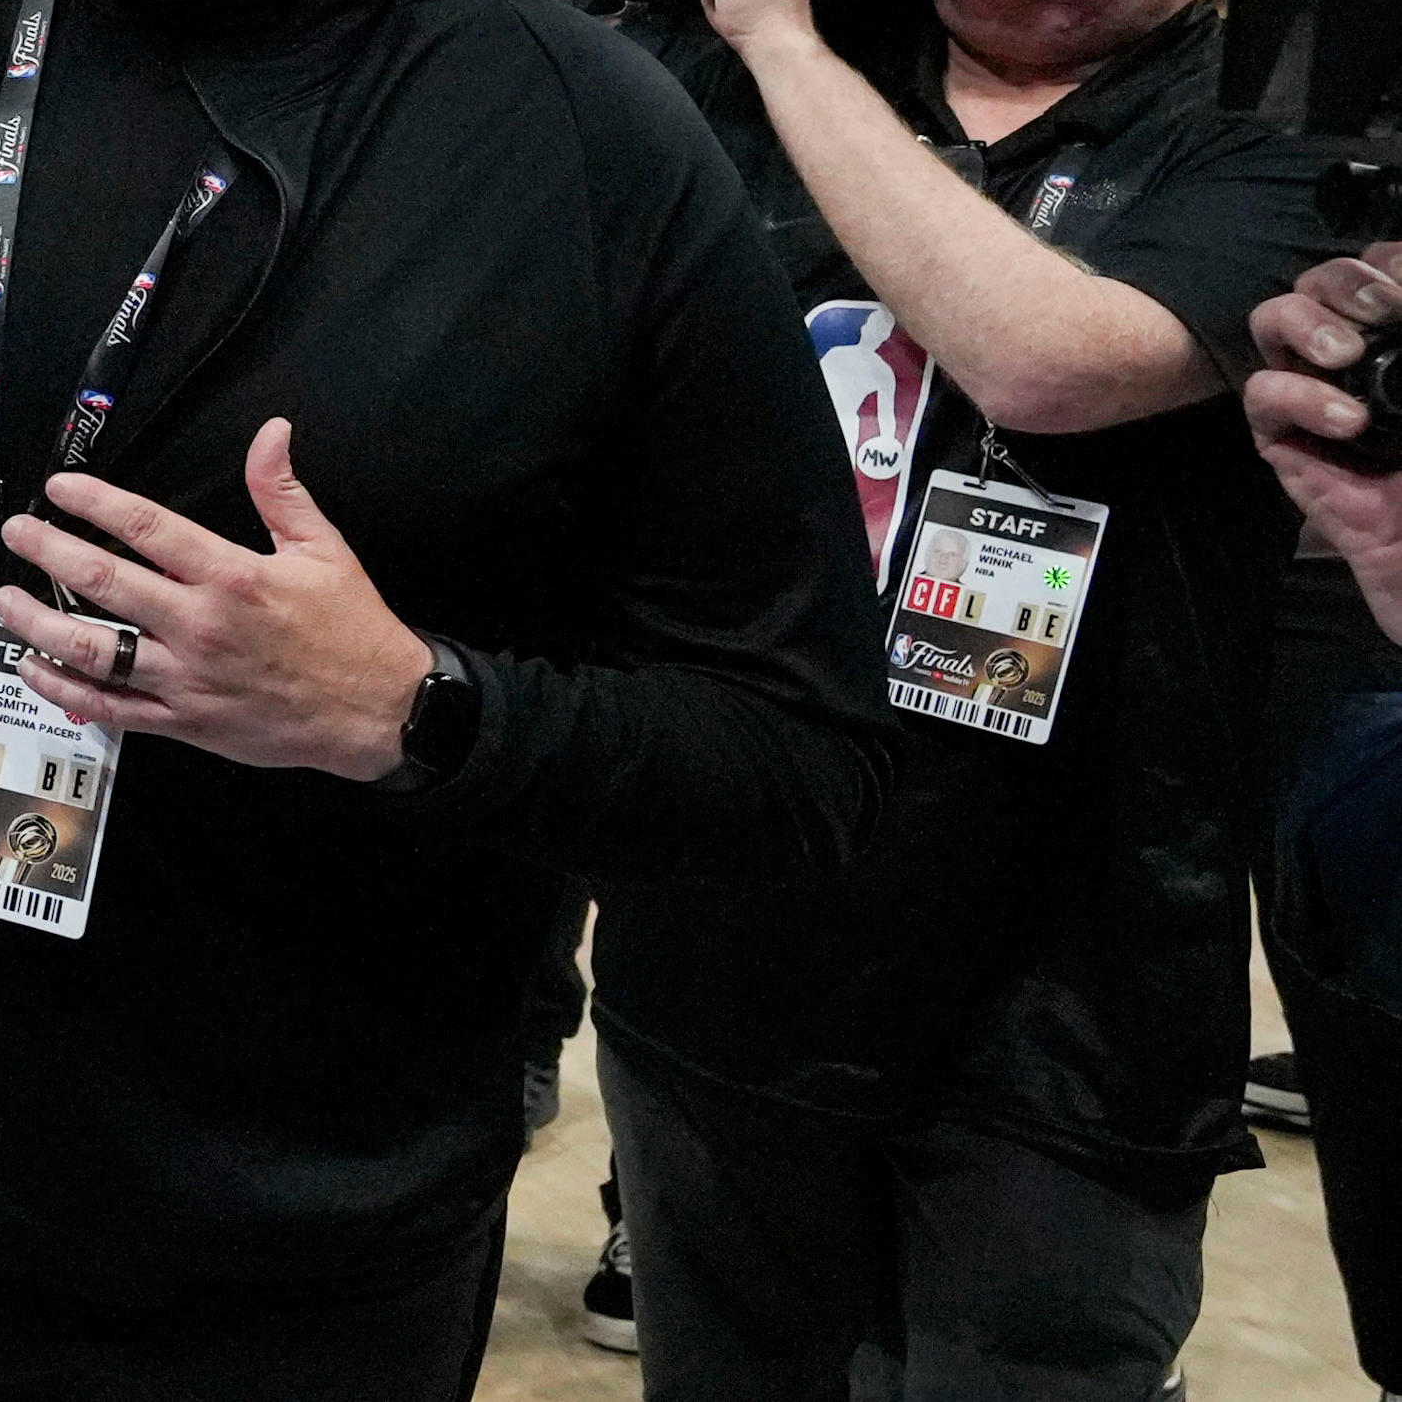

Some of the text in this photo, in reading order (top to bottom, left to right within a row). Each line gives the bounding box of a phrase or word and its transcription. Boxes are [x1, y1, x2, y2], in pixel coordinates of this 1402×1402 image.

[13, 11, 42, 68] Finals
[1031, 178, 1067, 229] Finals
[106, 287, 148, 348] Finals
[64, 398, 107, 467] Finals
[862, 447, 899, 468] MW
[969, 507, 1048, 539] STAFF
[979, 554, 1014, 570] WINIK
[981, 544, 1035, 564] MICHAEL
[912, 582, 974, 618] C F L
[1017, 607, 1059, 638] B E
[897, 640, 976, 678] Finals
[1022, 688, 1046, 707] 2025
[38, 723, 83, 741] PACERS
[41, 760, 88, 799] B E
[50, 863, 78, 885] 2025
